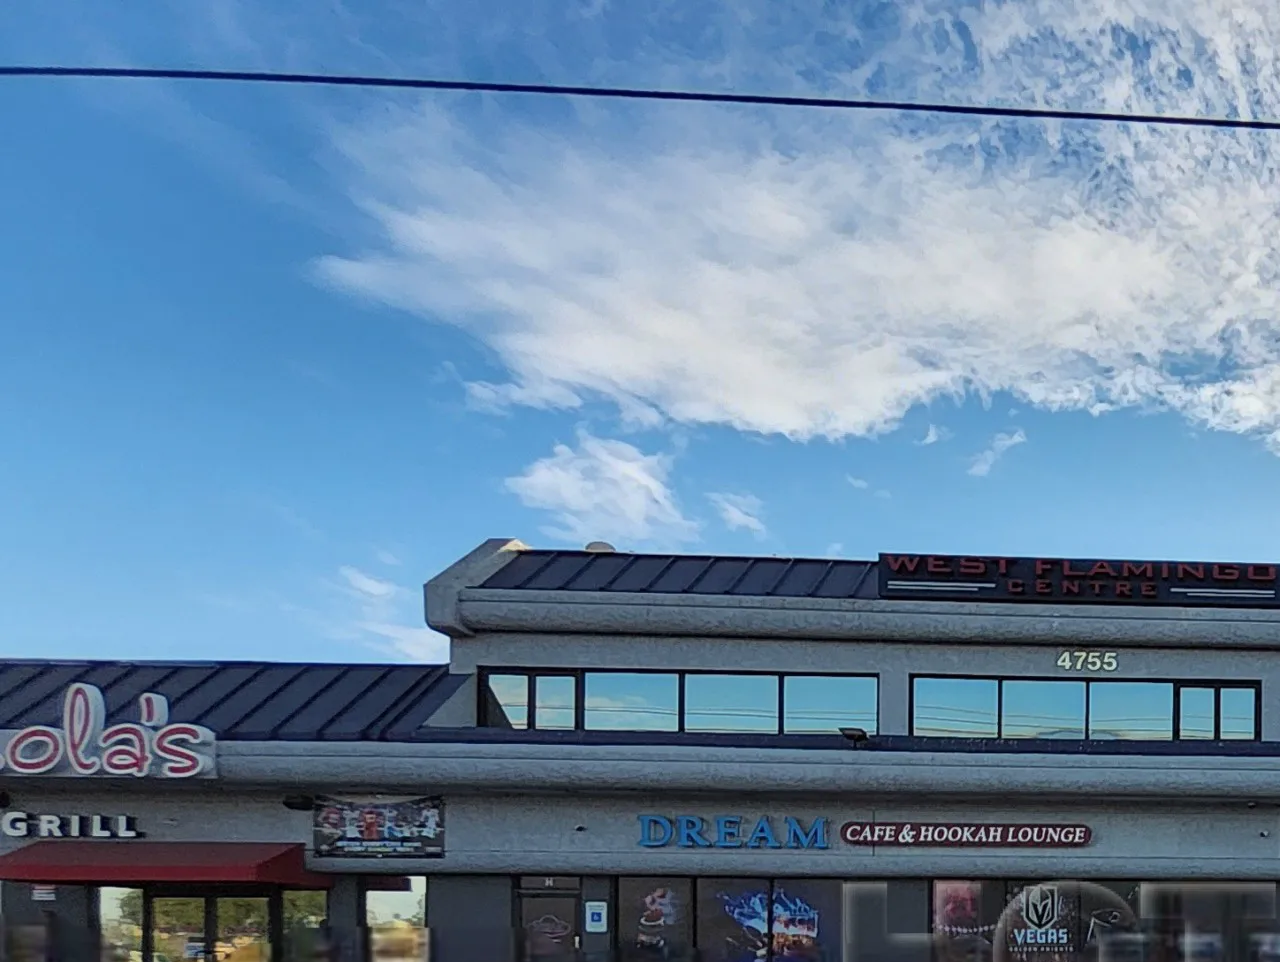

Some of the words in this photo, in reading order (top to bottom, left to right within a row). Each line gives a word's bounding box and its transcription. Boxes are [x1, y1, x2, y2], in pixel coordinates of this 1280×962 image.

[888, 555, 1009, 575] WEST
[1035, 558, 1278, 580] FLAMINGO
[1007, 578, 1158, 597] CENTRE
[1056, 650, 1119, 671] 4755
[0, 682, 212, 777] ola's
[1, 811, 138, 838] GRILL
[638, 814, 829, 849] DREAM
[846, 825, 896, 843] CAFE
[898, 824, 916, 844] &
[918, 825, 1003, 844] HOOKAH
[1006, 826, 1086, 844] LOUNGE
[1013, 928, 1069, 946] VEGAS
